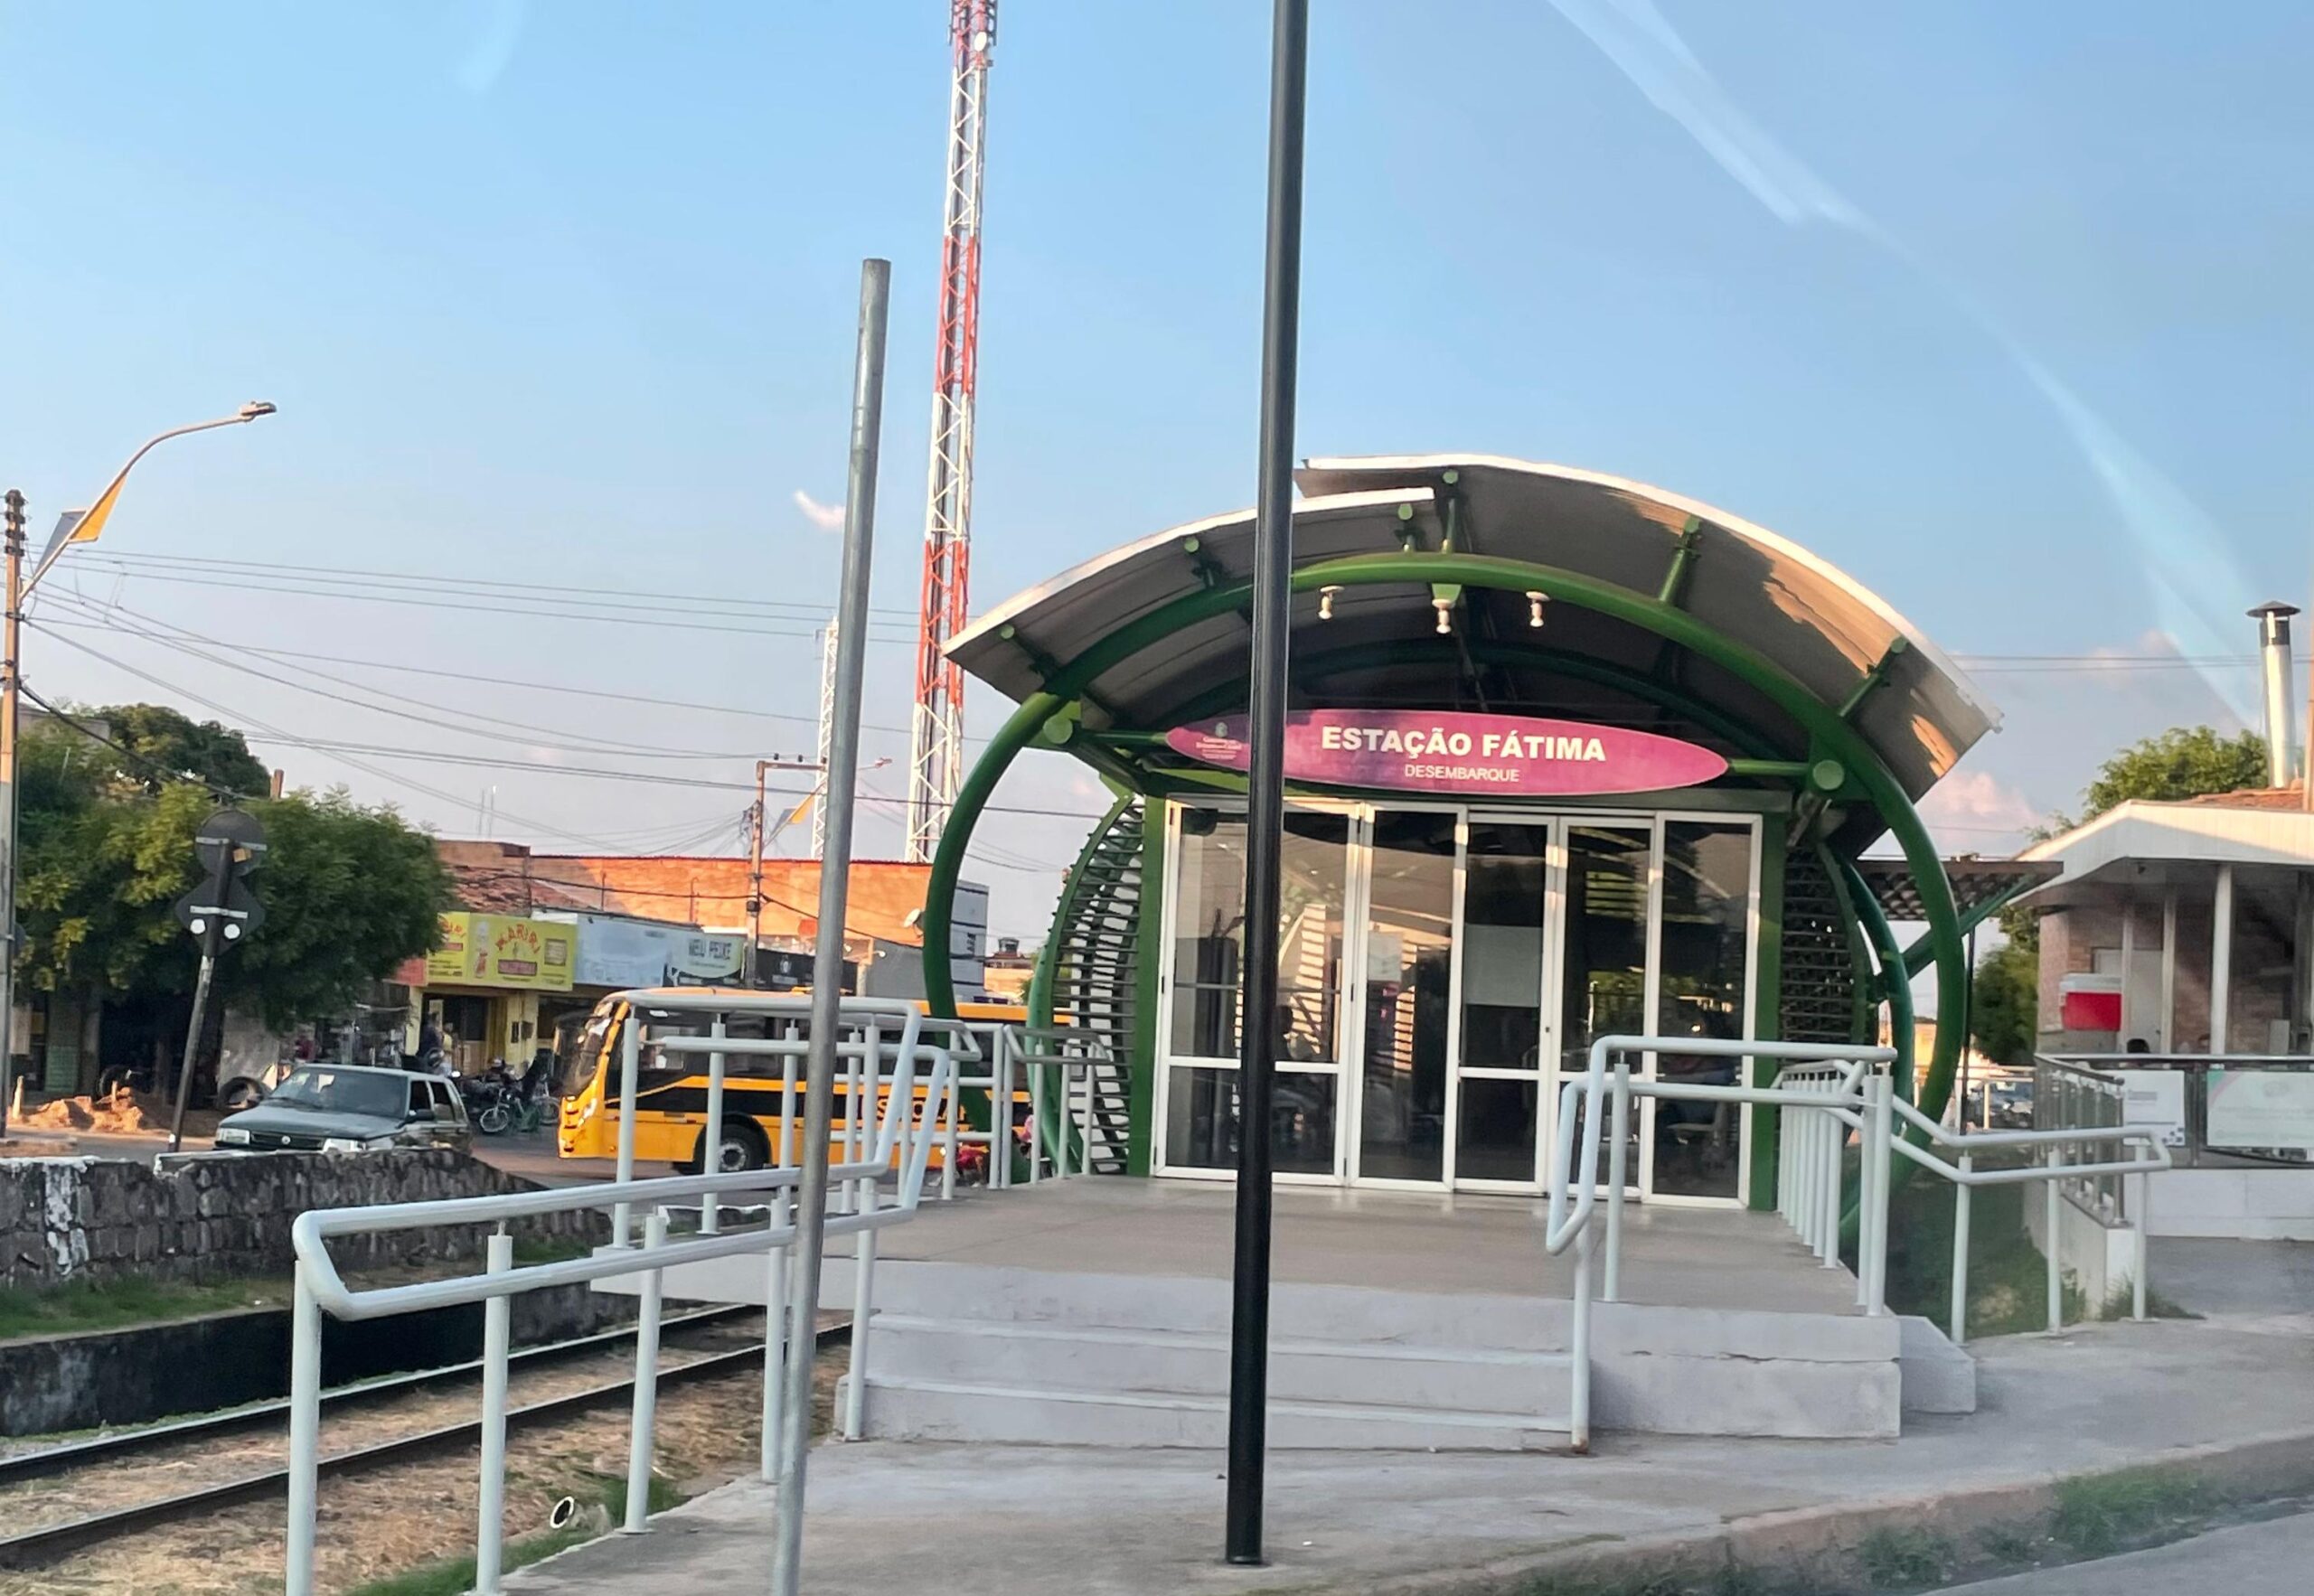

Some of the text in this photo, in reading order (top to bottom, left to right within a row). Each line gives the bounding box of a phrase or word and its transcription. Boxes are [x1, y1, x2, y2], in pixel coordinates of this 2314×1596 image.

[1322, 726, 1606, 762] ESTAÇÃO FÁTIMA
[1405, 764, 1520, 783] DESEMBARQUE
